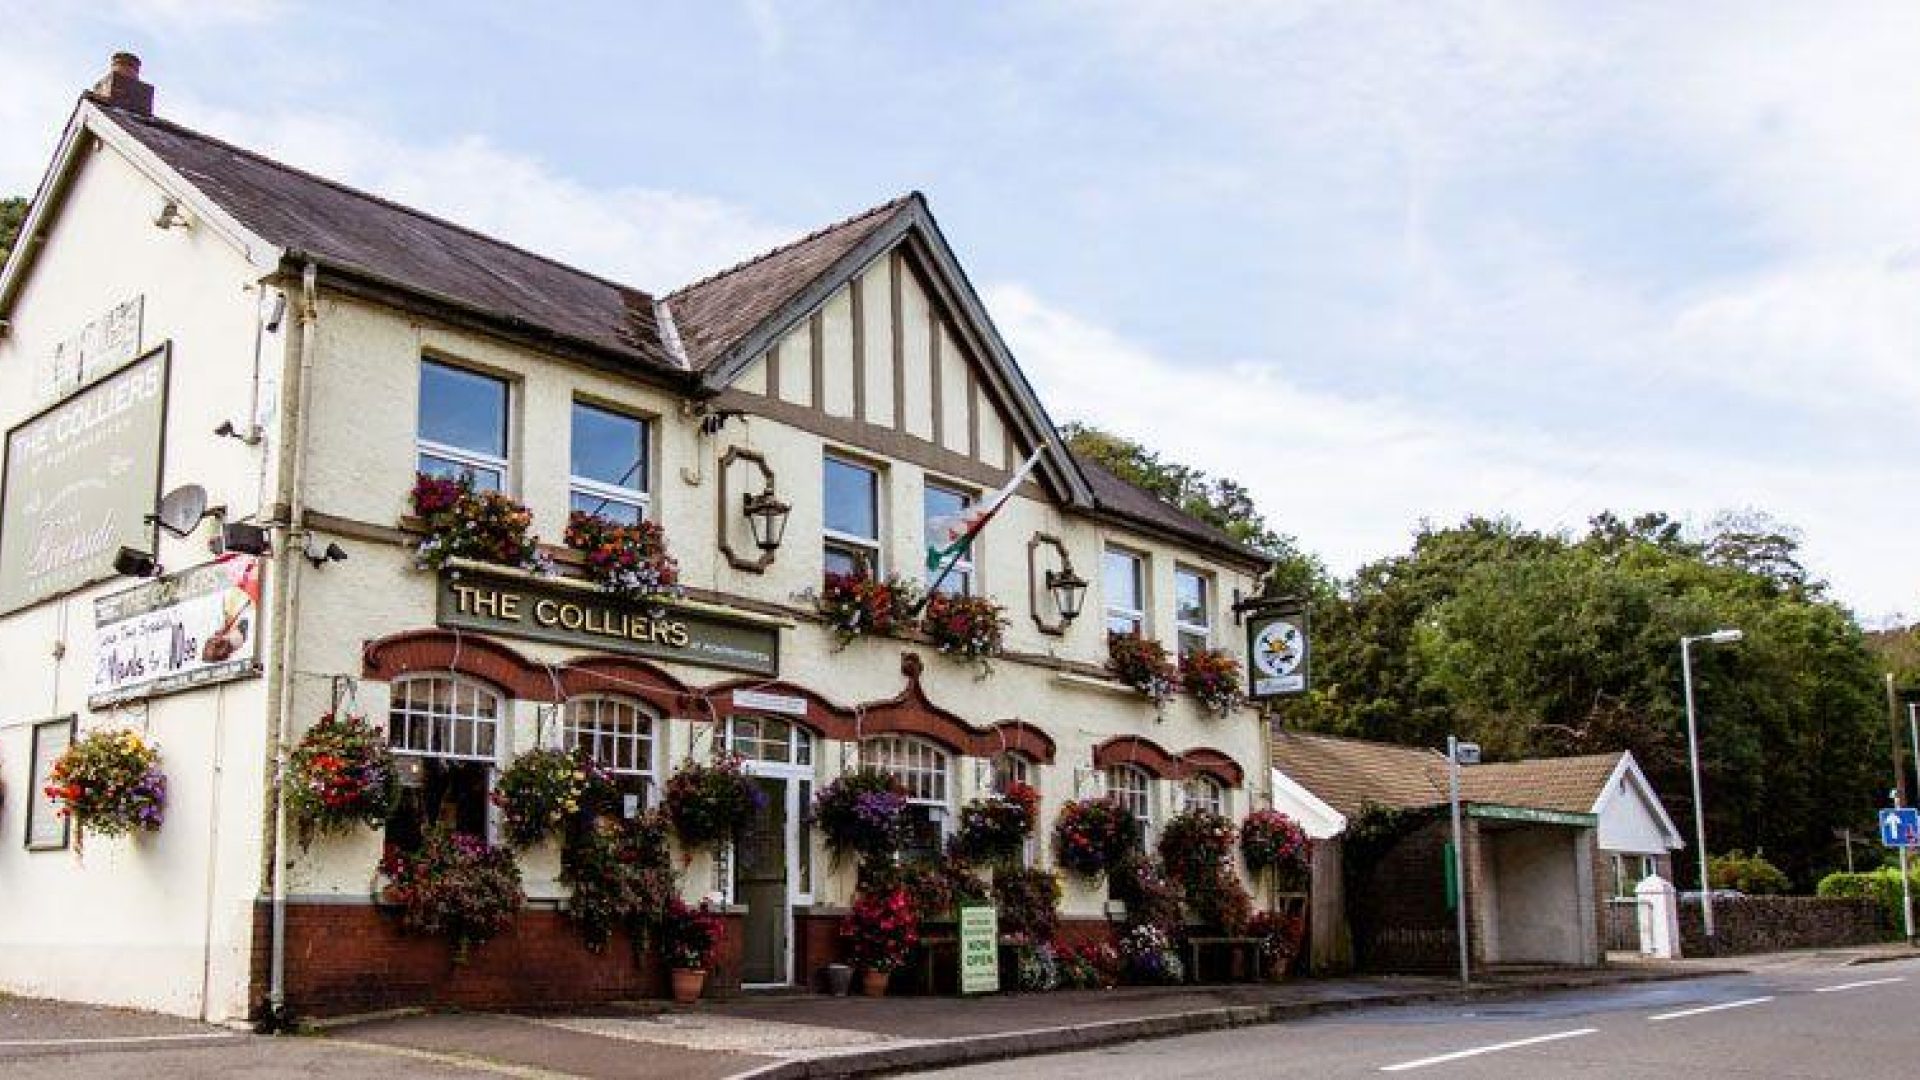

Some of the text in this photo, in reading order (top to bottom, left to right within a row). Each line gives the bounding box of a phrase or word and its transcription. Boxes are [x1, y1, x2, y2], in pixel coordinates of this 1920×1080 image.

[57, 366, 159, 441] COLLIERS
[453, 584, 689, 647] THE COLLIERS
[966, 939, 991, 951] NOW
[966, 954, 994, 967] OPEN
